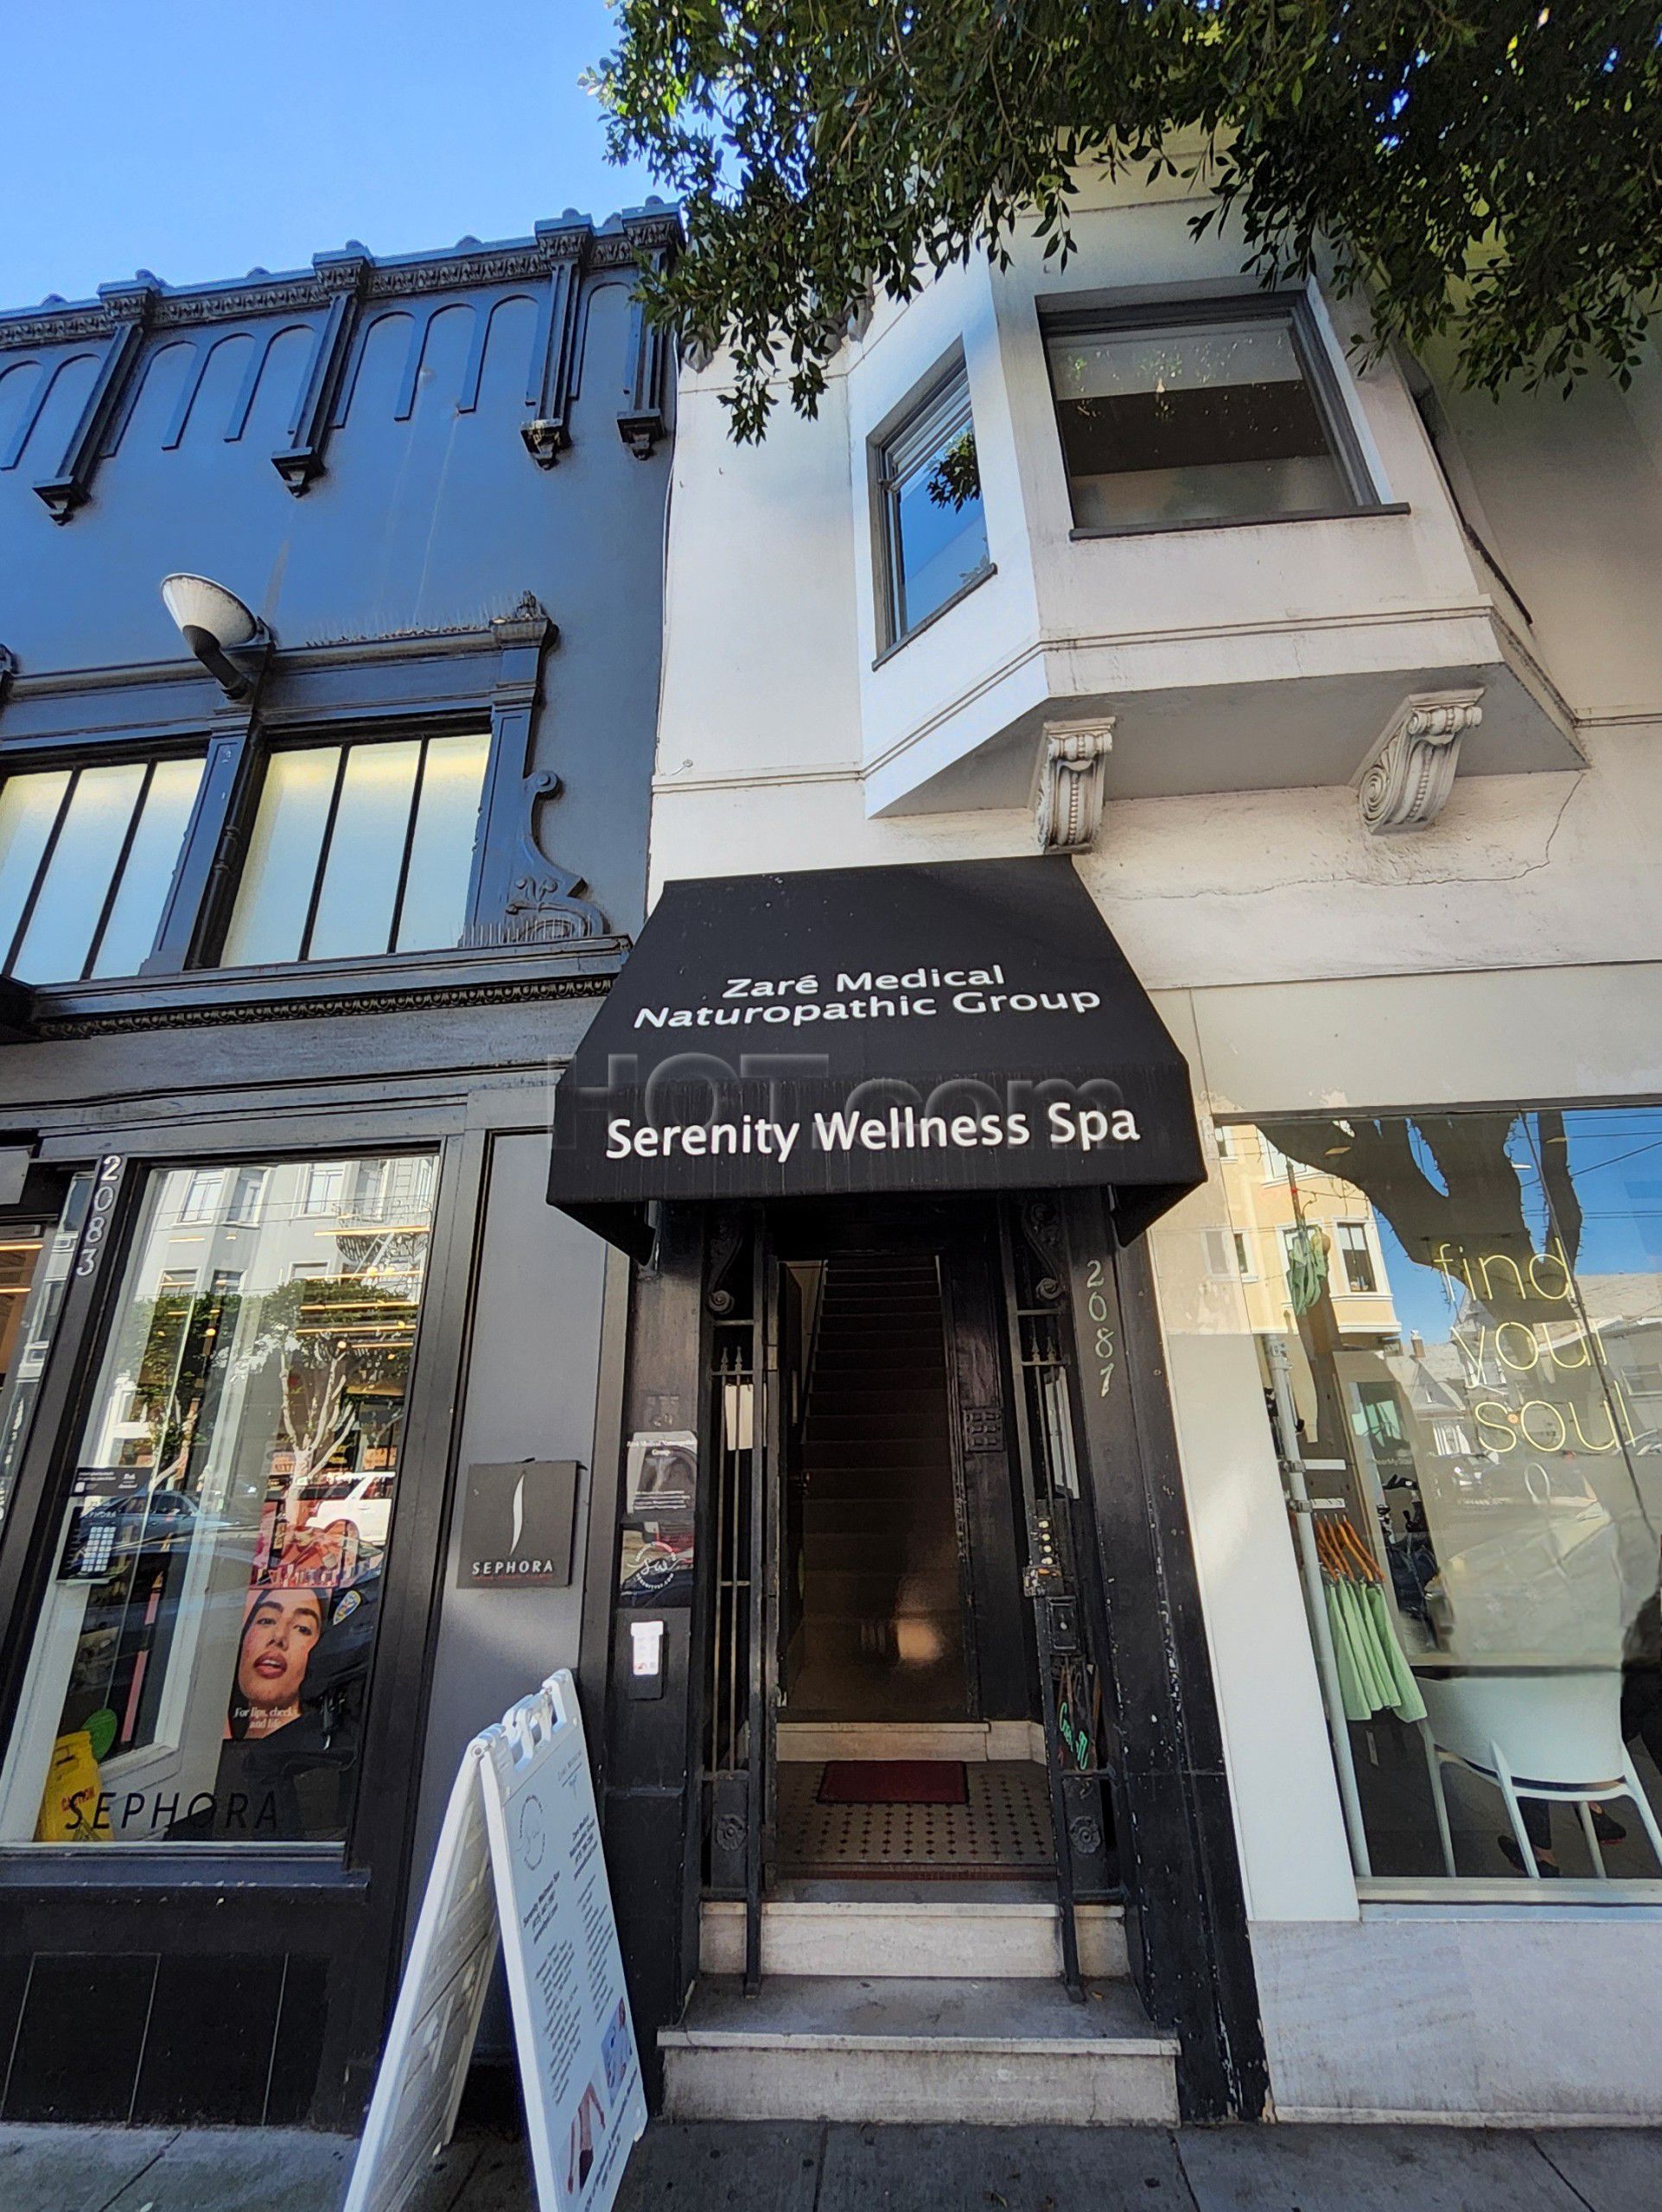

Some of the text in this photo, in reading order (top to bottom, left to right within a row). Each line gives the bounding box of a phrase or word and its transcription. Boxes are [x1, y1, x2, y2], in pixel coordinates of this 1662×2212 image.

[633, 989, 1101, 1029] Naturopathic Group
[721, 963, 1005, 999] Zaré Medical
[605, 1101, 1142, 1164] Serenity Wellness Spa
[76, 1154, 122, 1276] 2083
[1434, 1237, 1576, 1302] find
[1450, 1320, 1608, 1389] your
[1474, 1380, 1637, 1453] soul
[471, 1559, 554, 1575] SEPHORA
[65, 1791, 277, 1831] SEPHORA
